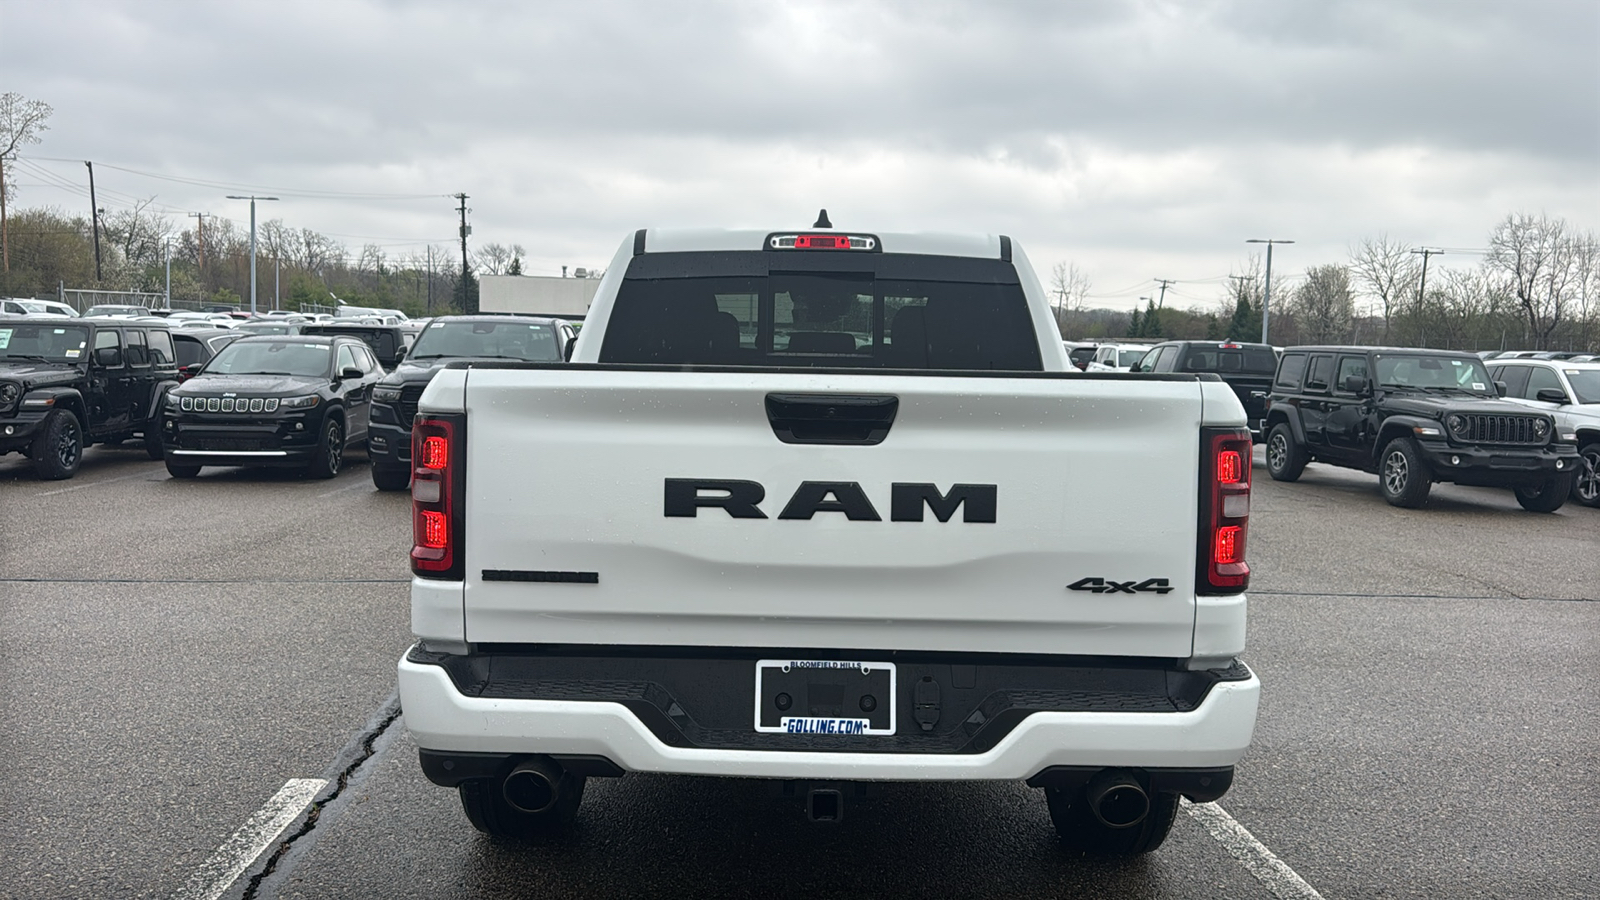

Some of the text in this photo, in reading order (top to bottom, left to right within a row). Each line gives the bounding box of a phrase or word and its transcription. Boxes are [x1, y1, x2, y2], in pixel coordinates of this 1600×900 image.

[664, 478, 997, 523] RAM
[1066, 577, 1175, 594] 4x4
[790, 661, 838, 669] BLOOMFIELD
[787, 719, 863, 734] GOLLING.COM
